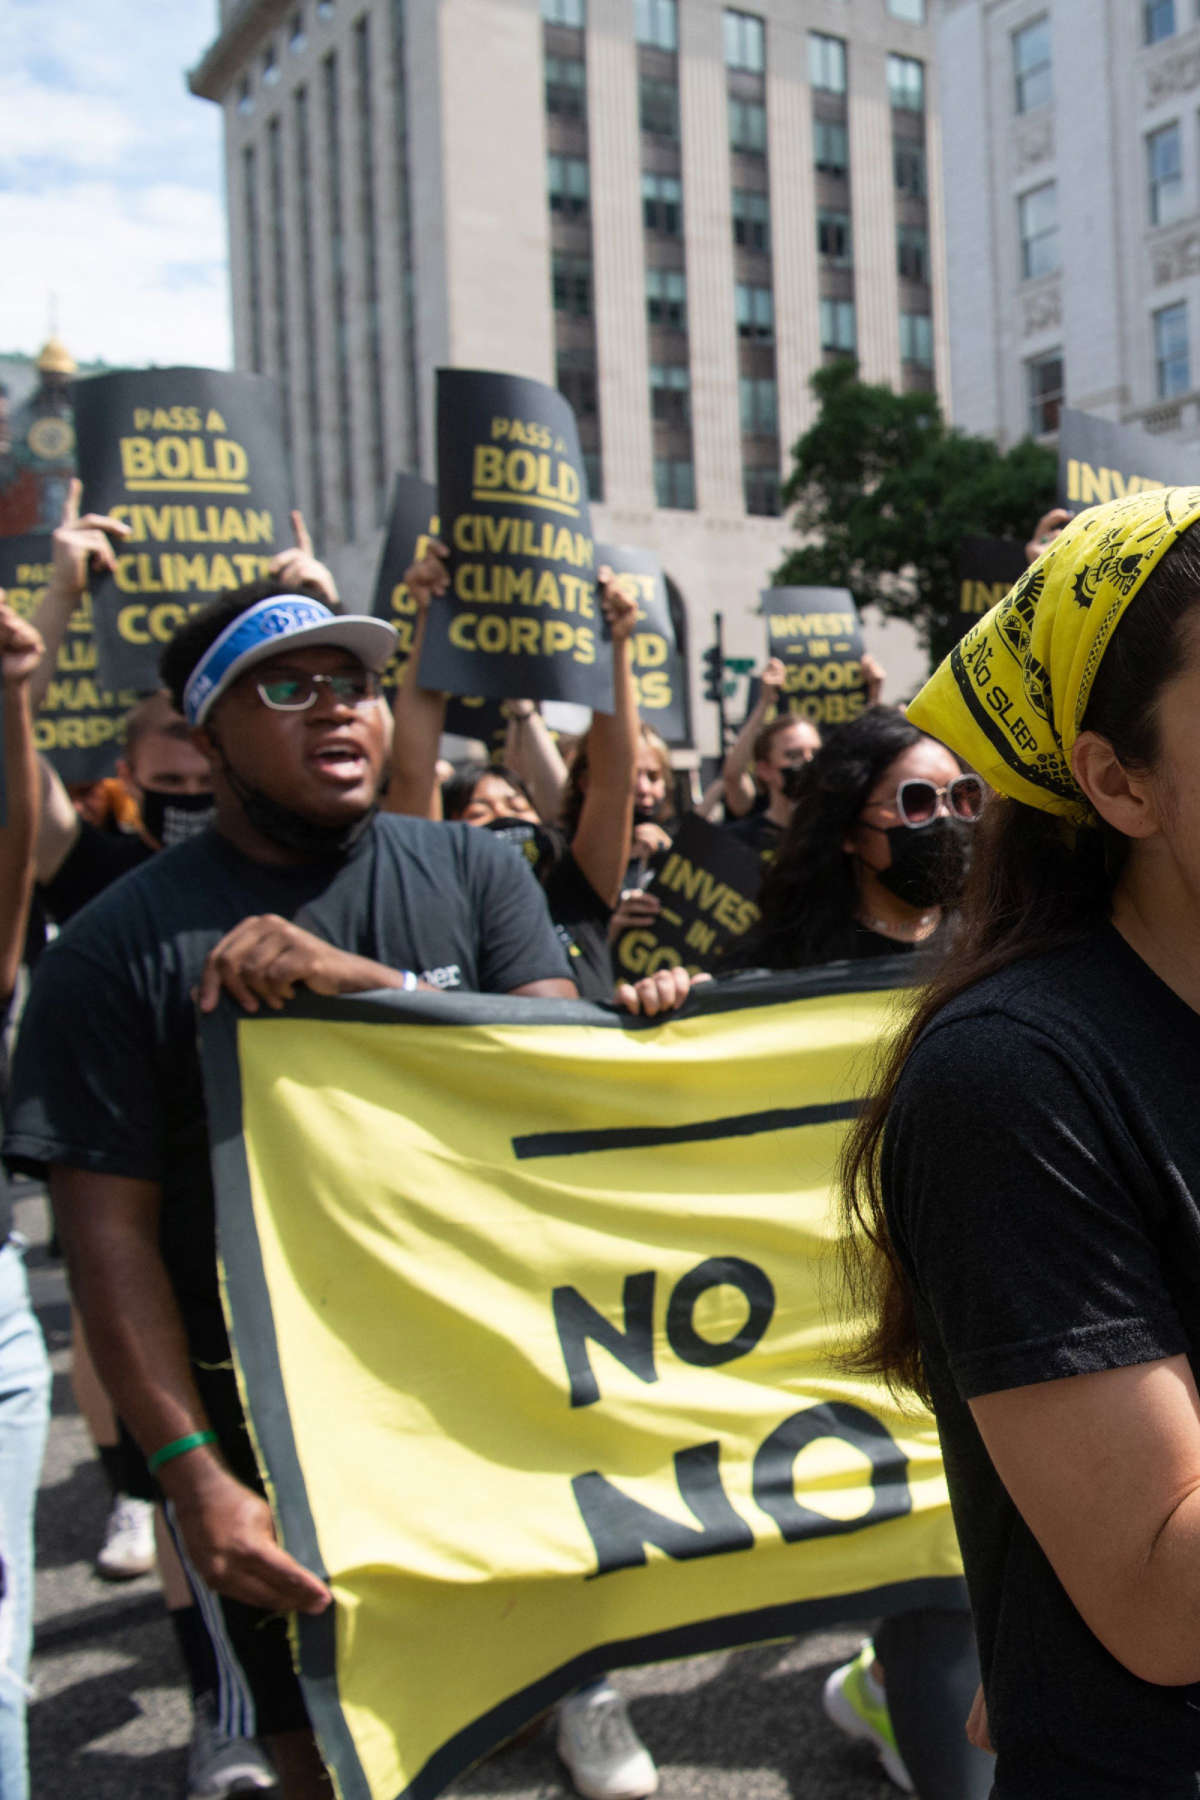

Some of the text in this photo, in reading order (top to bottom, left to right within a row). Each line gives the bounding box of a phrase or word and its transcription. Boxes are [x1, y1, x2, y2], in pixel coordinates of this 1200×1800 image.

[134, 406, 227, 433] PASS A
[491, 417, 552, 450] PASS
[119, 435, 250, 481] BOLD
[472, 445, 581, 505] BOLD
[1067, 458, 1170, 507] INV
[109, 504, 275, 545] CIVILIAN
[453, 513, 595, 569] CIVILIAN
[454, 563, 595, 621] CLIMATE
[449, 612, 596, 665] CORPS
[769, 612, 854, 639] INVEST
[807, 638, 831, 658] IN
[986, 686, 1038, 751] SLEEP
[659, 852, 761, 936] INVES
[551, 1255, 776, 1409] NO
[570, 1400, 914, 1581] NO
